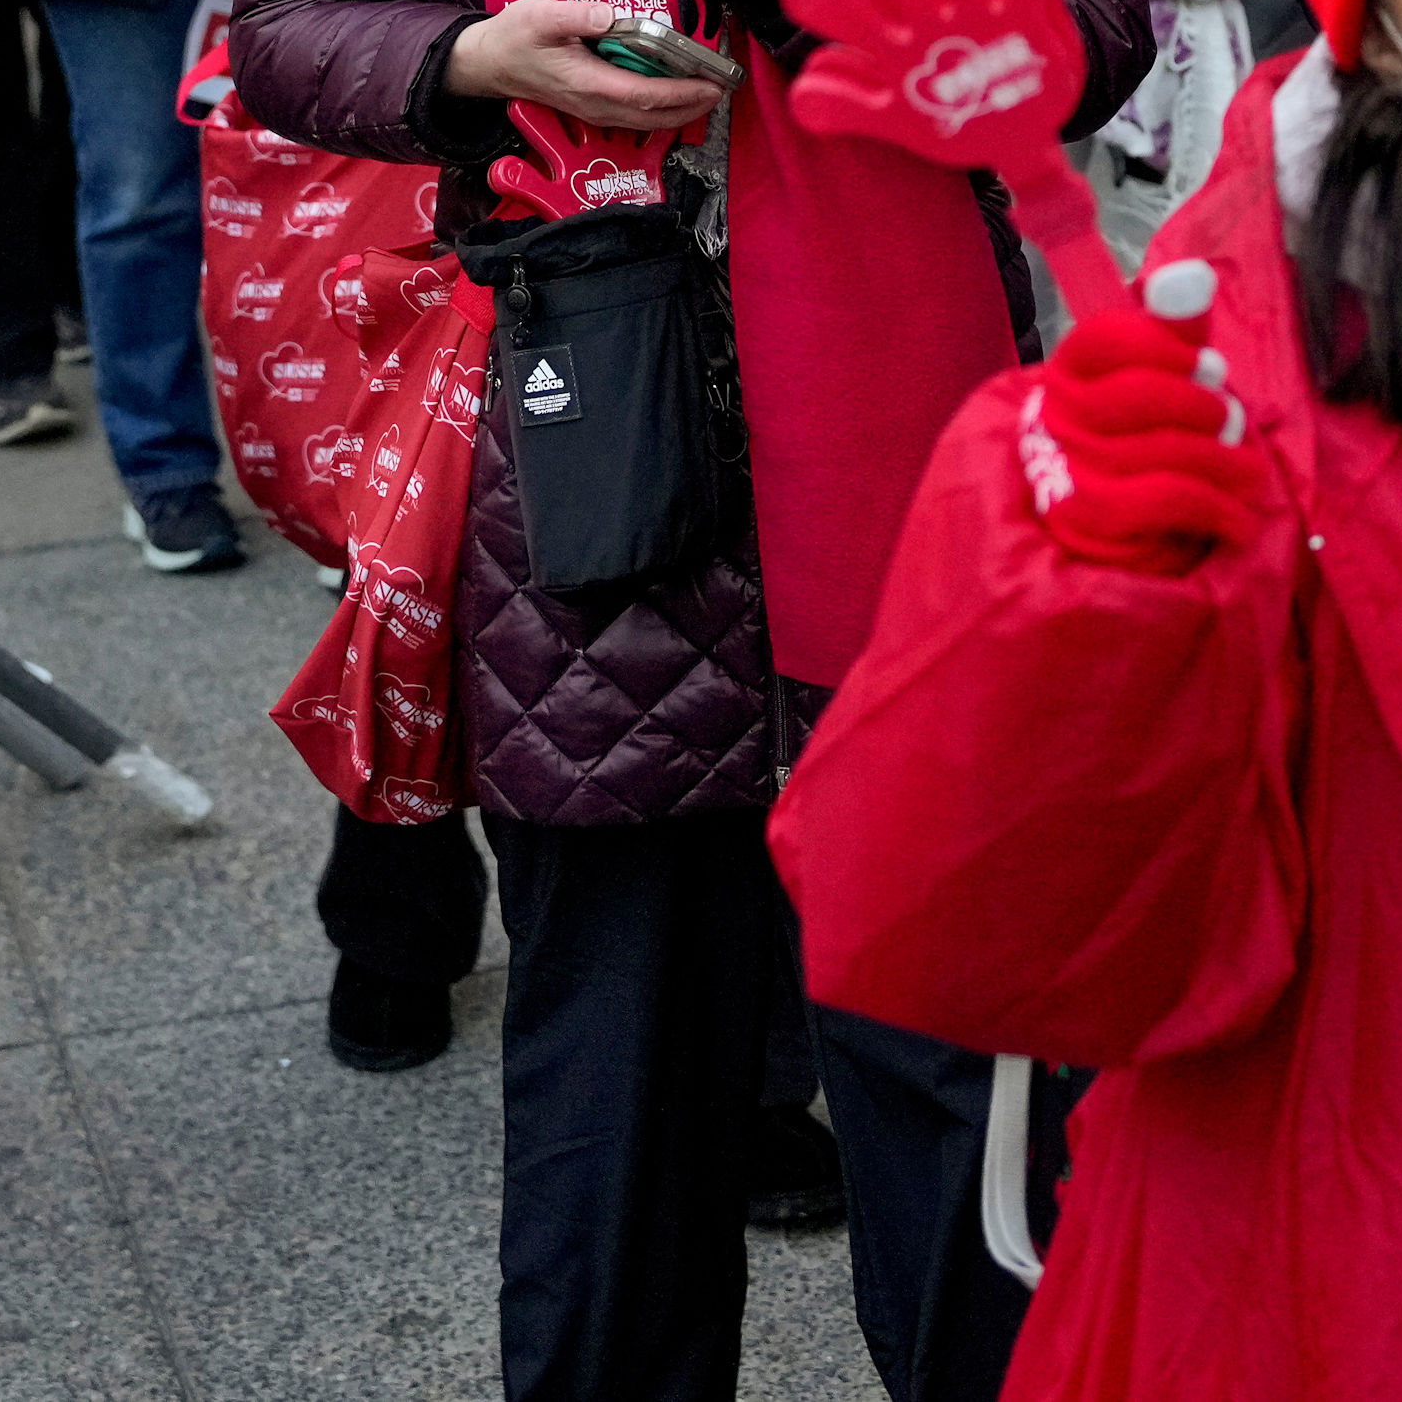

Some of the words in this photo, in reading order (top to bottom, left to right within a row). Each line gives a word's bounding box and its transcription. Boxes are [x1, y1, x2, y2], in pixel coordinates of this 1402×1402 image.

[585, 173, 648, 195] NURSES
[524, 378, 565, 394] adidas
[373, 578, 442, 630] NURSES
